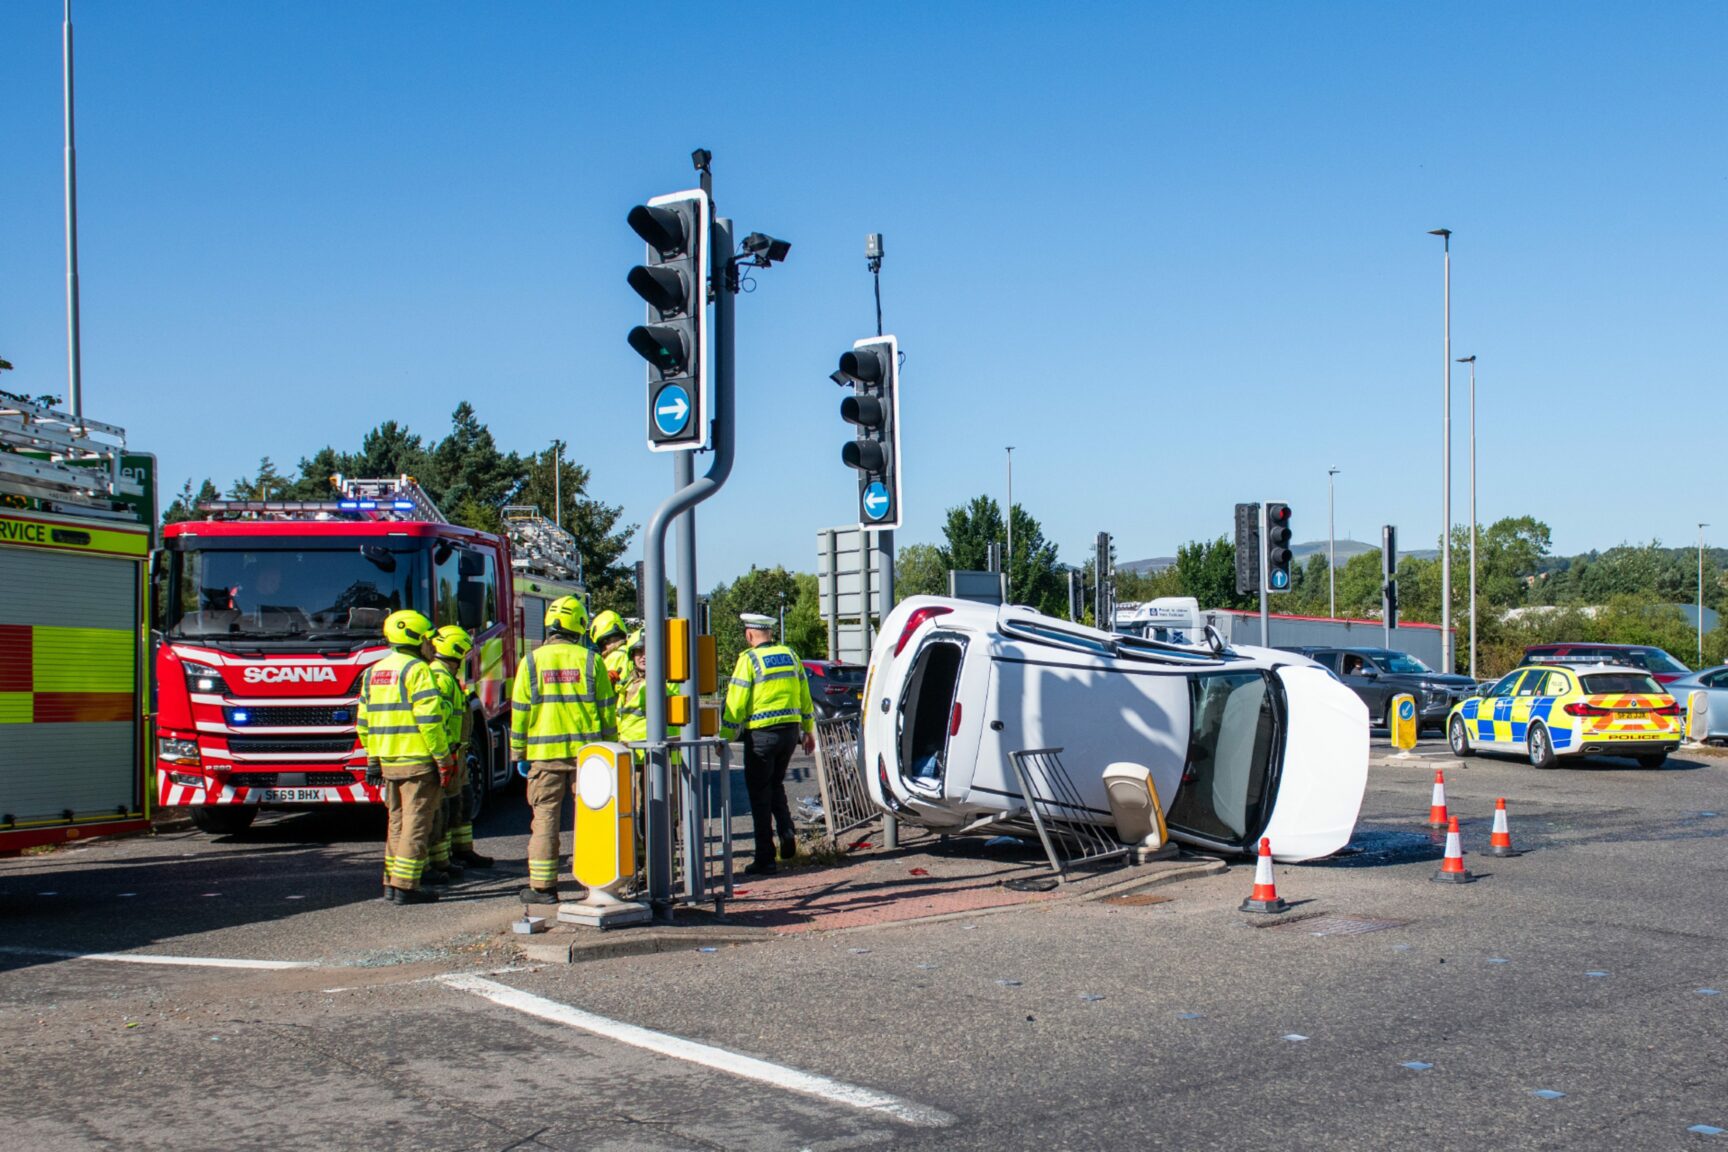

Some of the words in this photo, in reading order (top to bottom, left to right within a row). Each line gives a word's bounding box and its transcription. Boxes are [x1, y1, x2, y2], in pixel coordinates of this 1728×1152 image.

[764, 655, 793, 667] POLICE
[243, 666, 338, 684] SCANIA
[561, 669, 579, 677] AND
[265, 789, 295, 801] SF69
[298, 789, 320, 801] BHX
